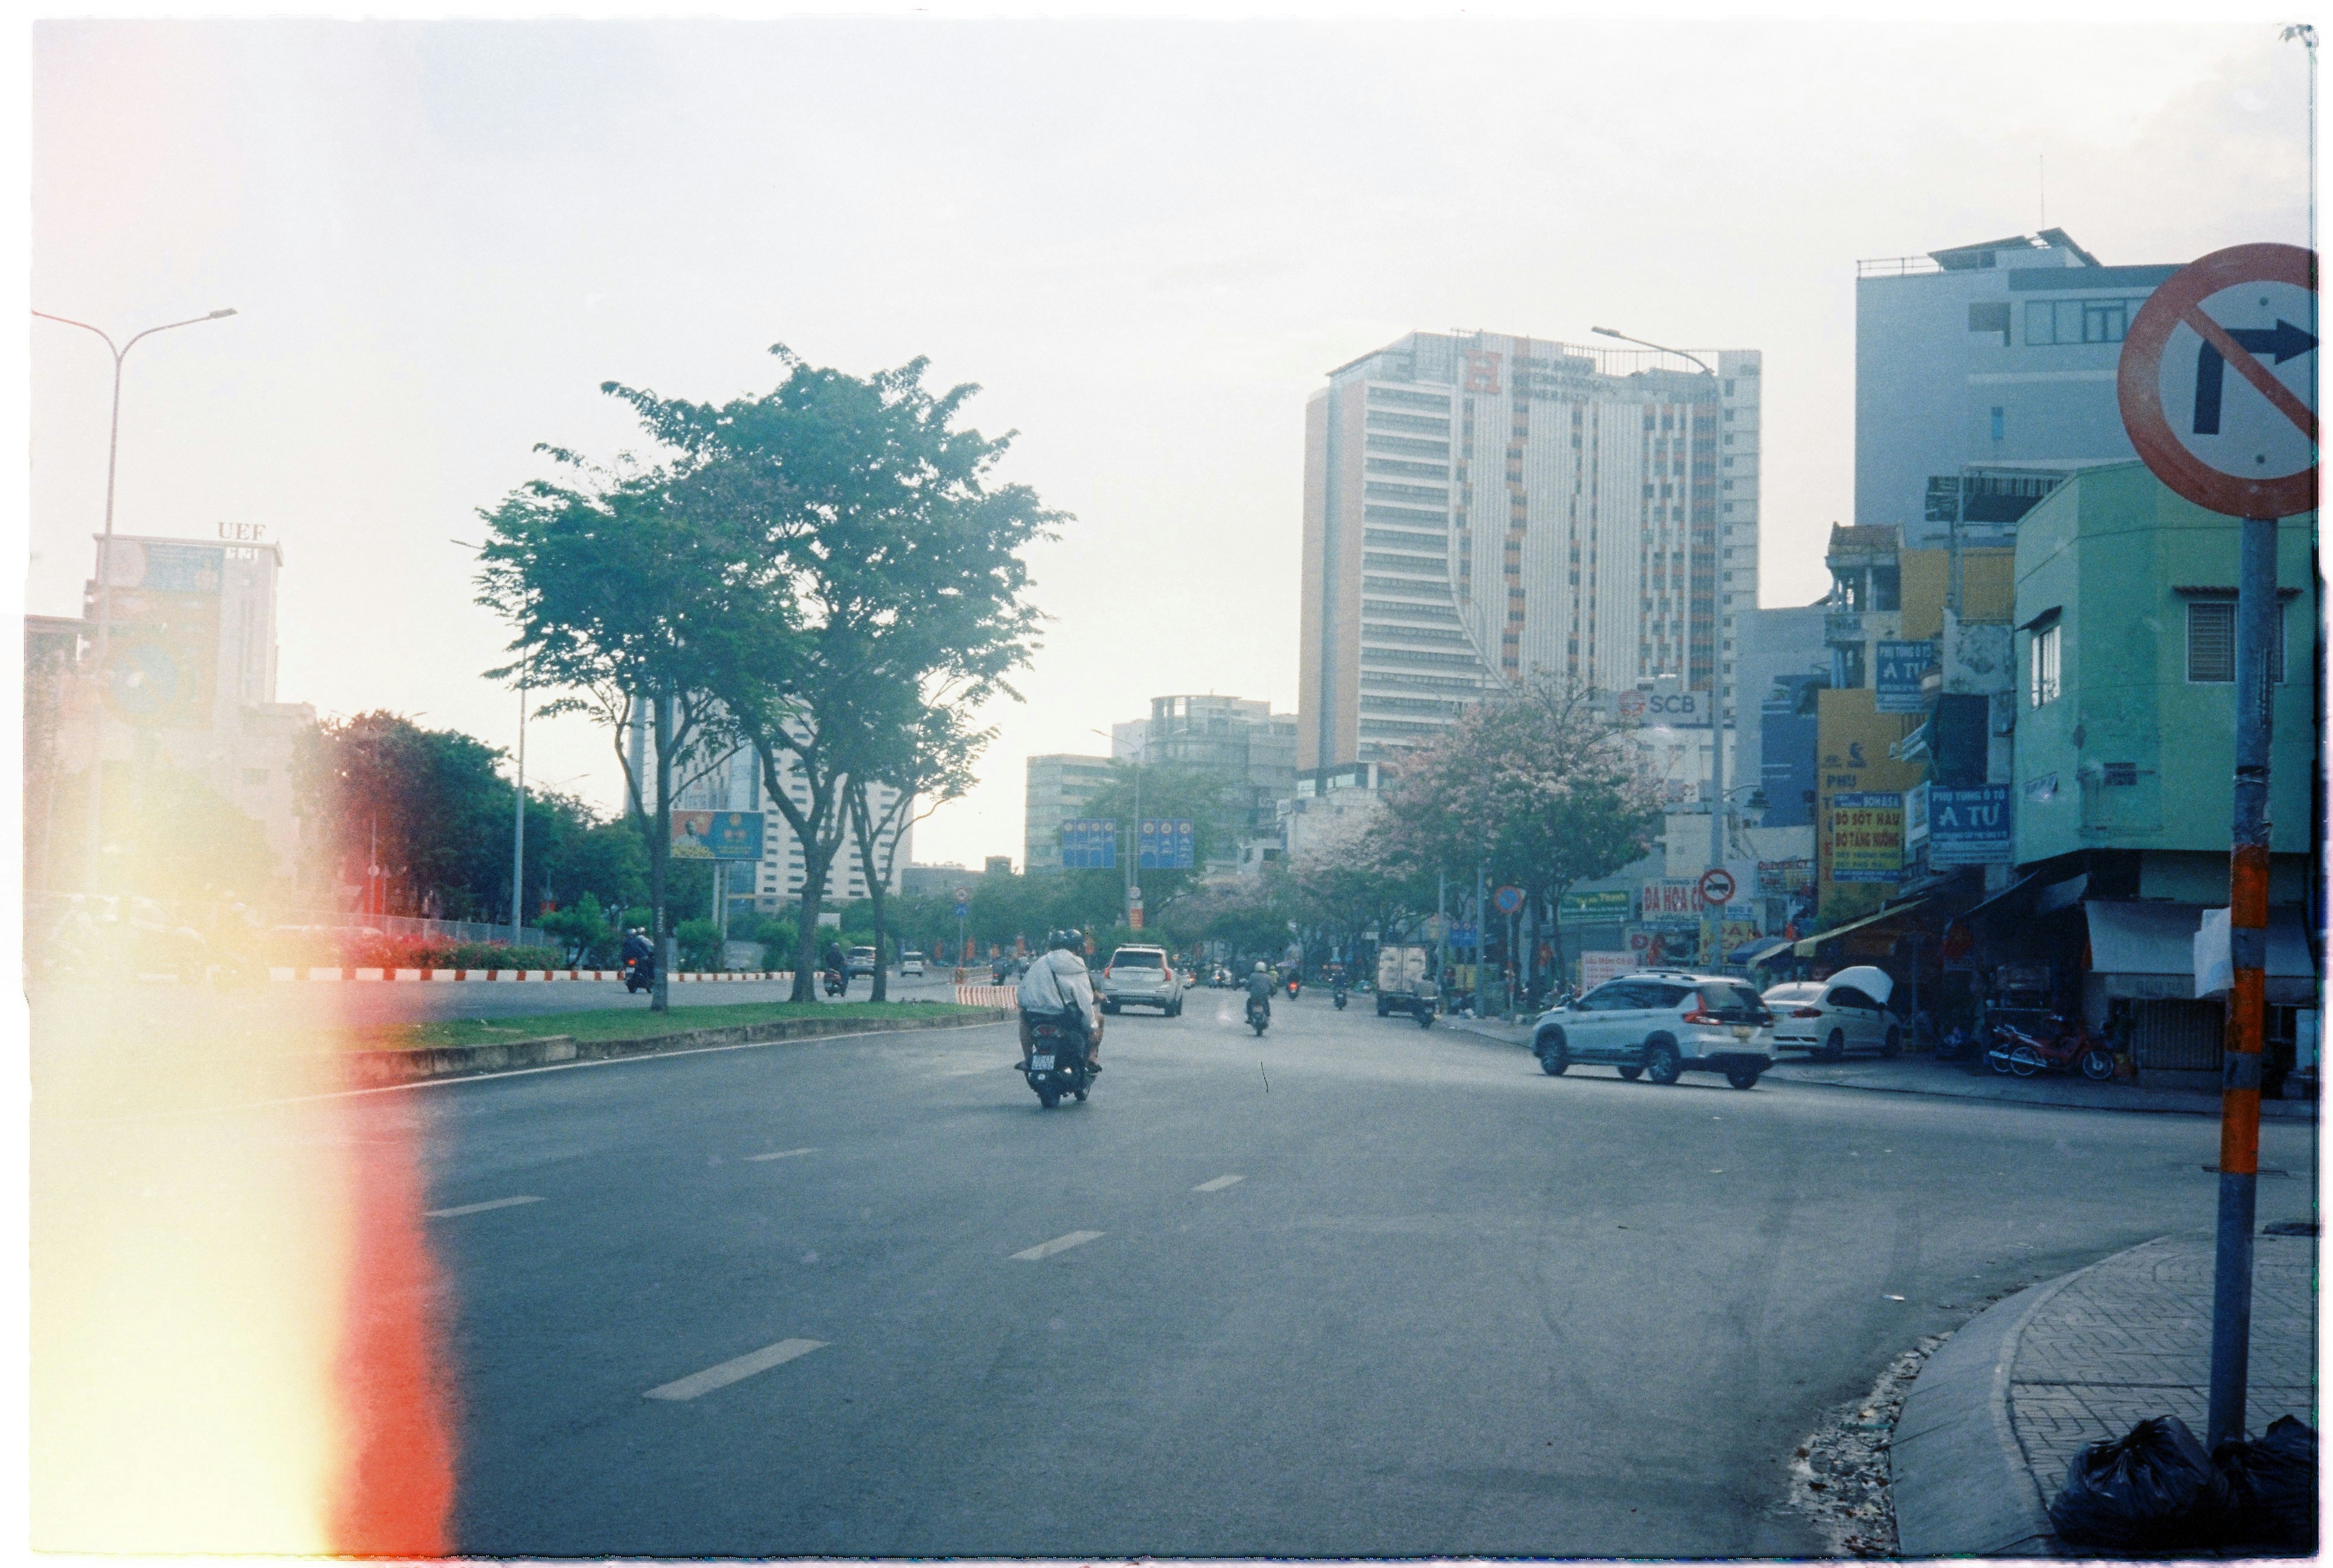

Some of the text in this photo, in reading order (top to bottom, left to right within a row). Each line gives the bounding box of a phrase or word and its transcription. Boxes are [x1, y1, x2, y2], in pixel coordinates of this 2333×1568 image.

[218, 522, 266, 541] UEF
[1883, 662, 1897, 678] A
[1650, 695, 1695, 713] SCB
[1938, 806, 1958, 827] A
